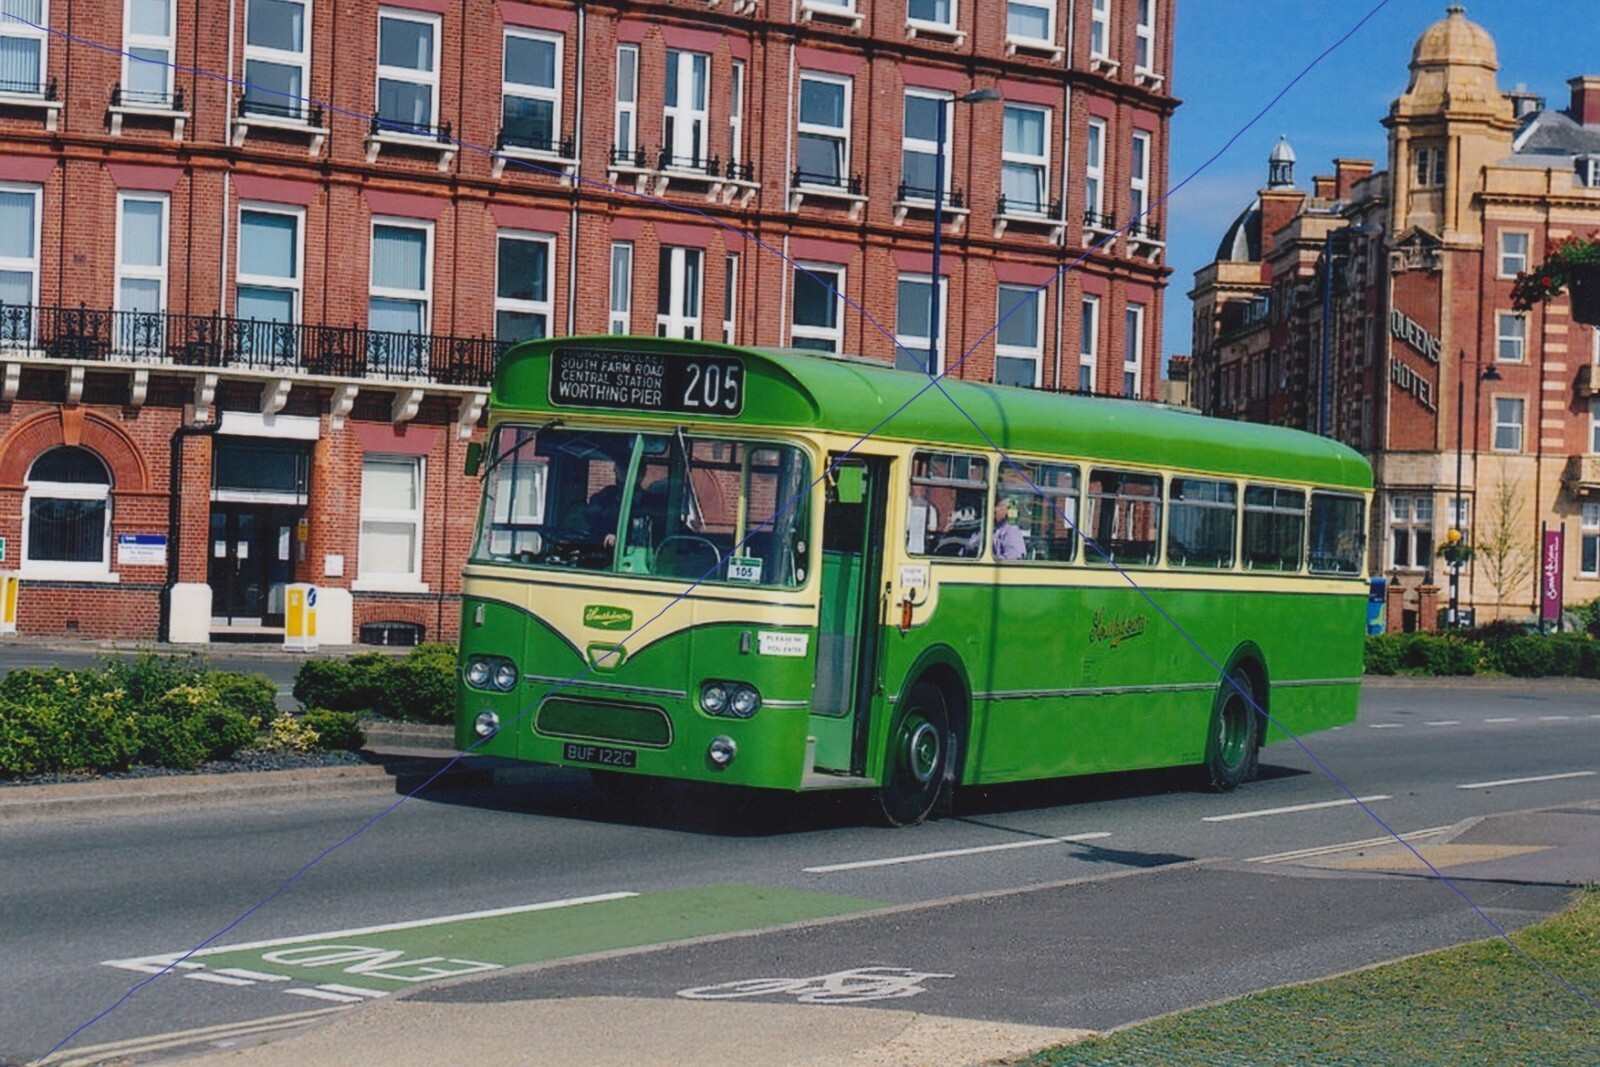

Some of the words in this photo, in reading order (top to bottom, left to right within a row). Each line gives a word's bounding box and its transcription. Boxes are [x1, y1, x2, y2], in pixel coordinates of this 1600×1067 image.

[1392, 309, 1441, 362] QUEENS
[561, 358, 597, 371] SOUTH
[601, 361, 631, 374] FARM
[635, 364, 664, 377] ROAD
[561, 369, 610, 384] CENTRAL
[616, 374, 662, 389] STATION
[684, 363, 739, 409] 205
[1392, 357, 1437, 412] HOTEL
[559, 382, 628, 402] WORTHING
[631, 388, 662, 406] PIER
[735, 566, 753, 577] 105
[568, 745, 596, 760] BUF
[600, 750, 632, 765] 122C
